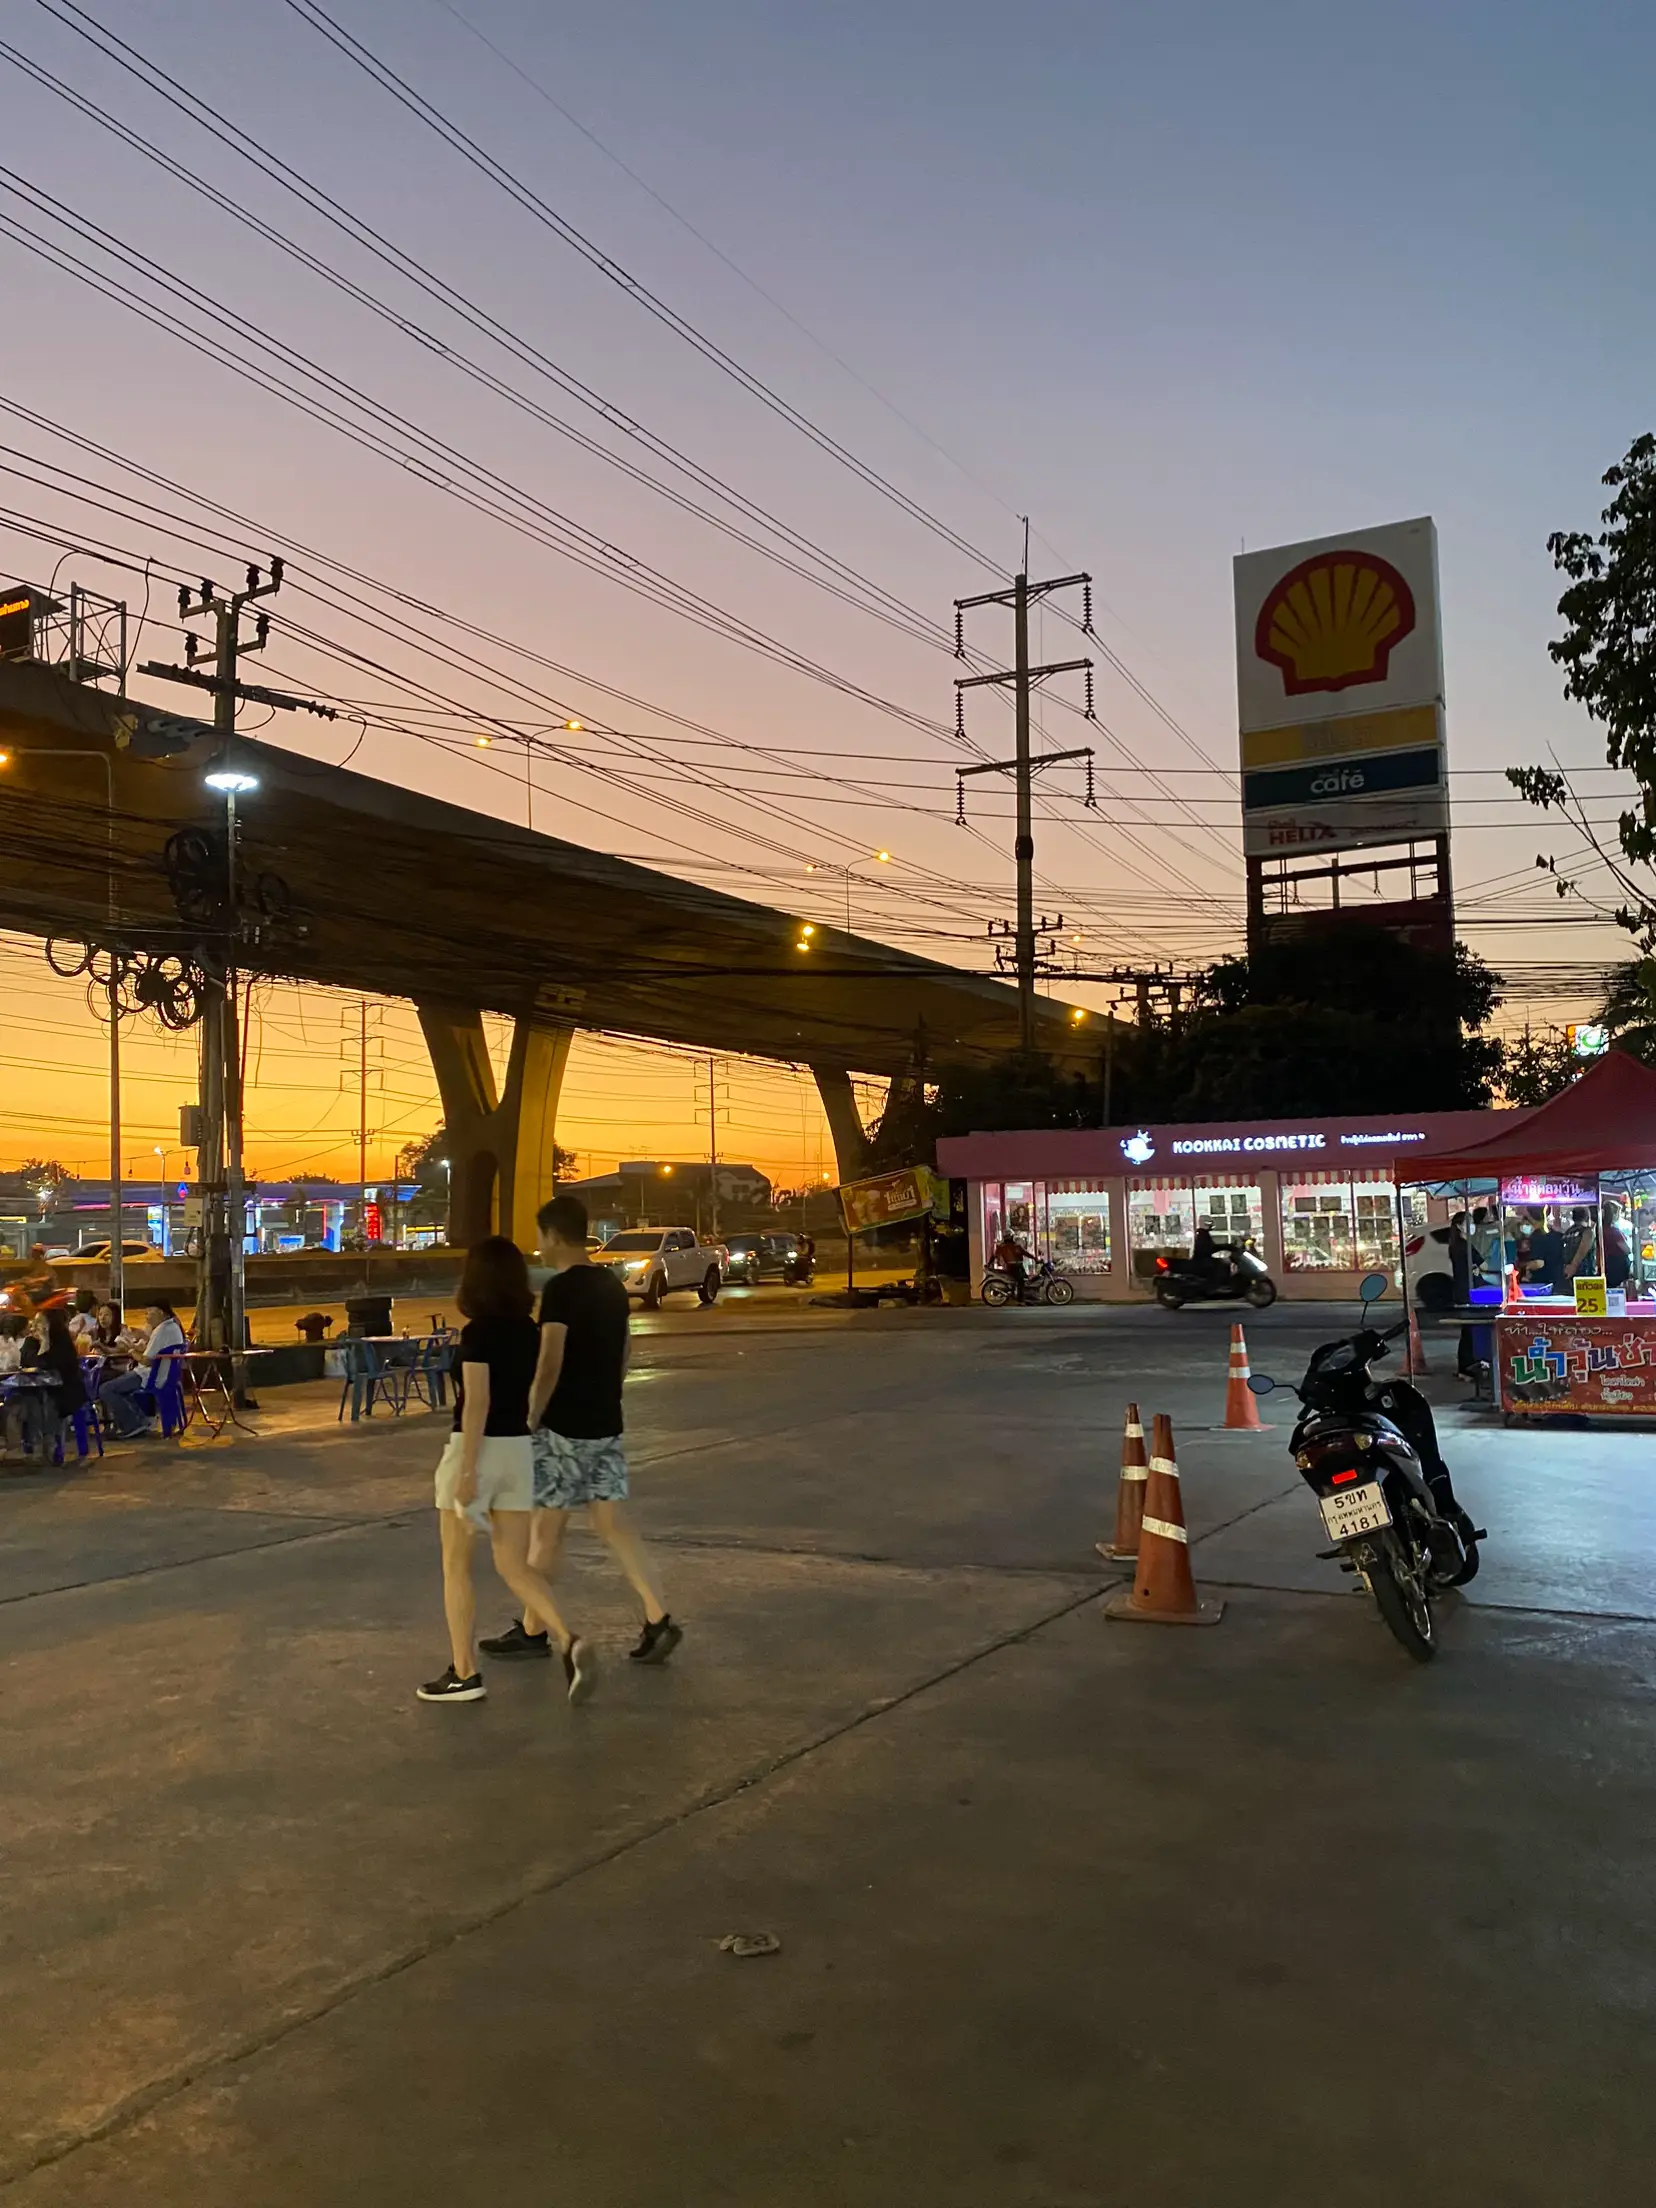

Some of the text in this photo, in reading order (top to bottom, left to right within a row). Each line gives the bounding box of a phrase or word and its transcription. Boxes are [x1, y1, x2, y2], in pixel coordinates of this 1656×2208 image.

[1310, 769, 1365, 794] café
[1269, 822, 1337, 845] HELIX
[1172, 1133, 1327, 1154] KOOKKAI COSMETIC
[1327, 1501, 1382, 1525] กรุงเทพมหานคร
[1339, 1513, 1380, 1536] 4181
